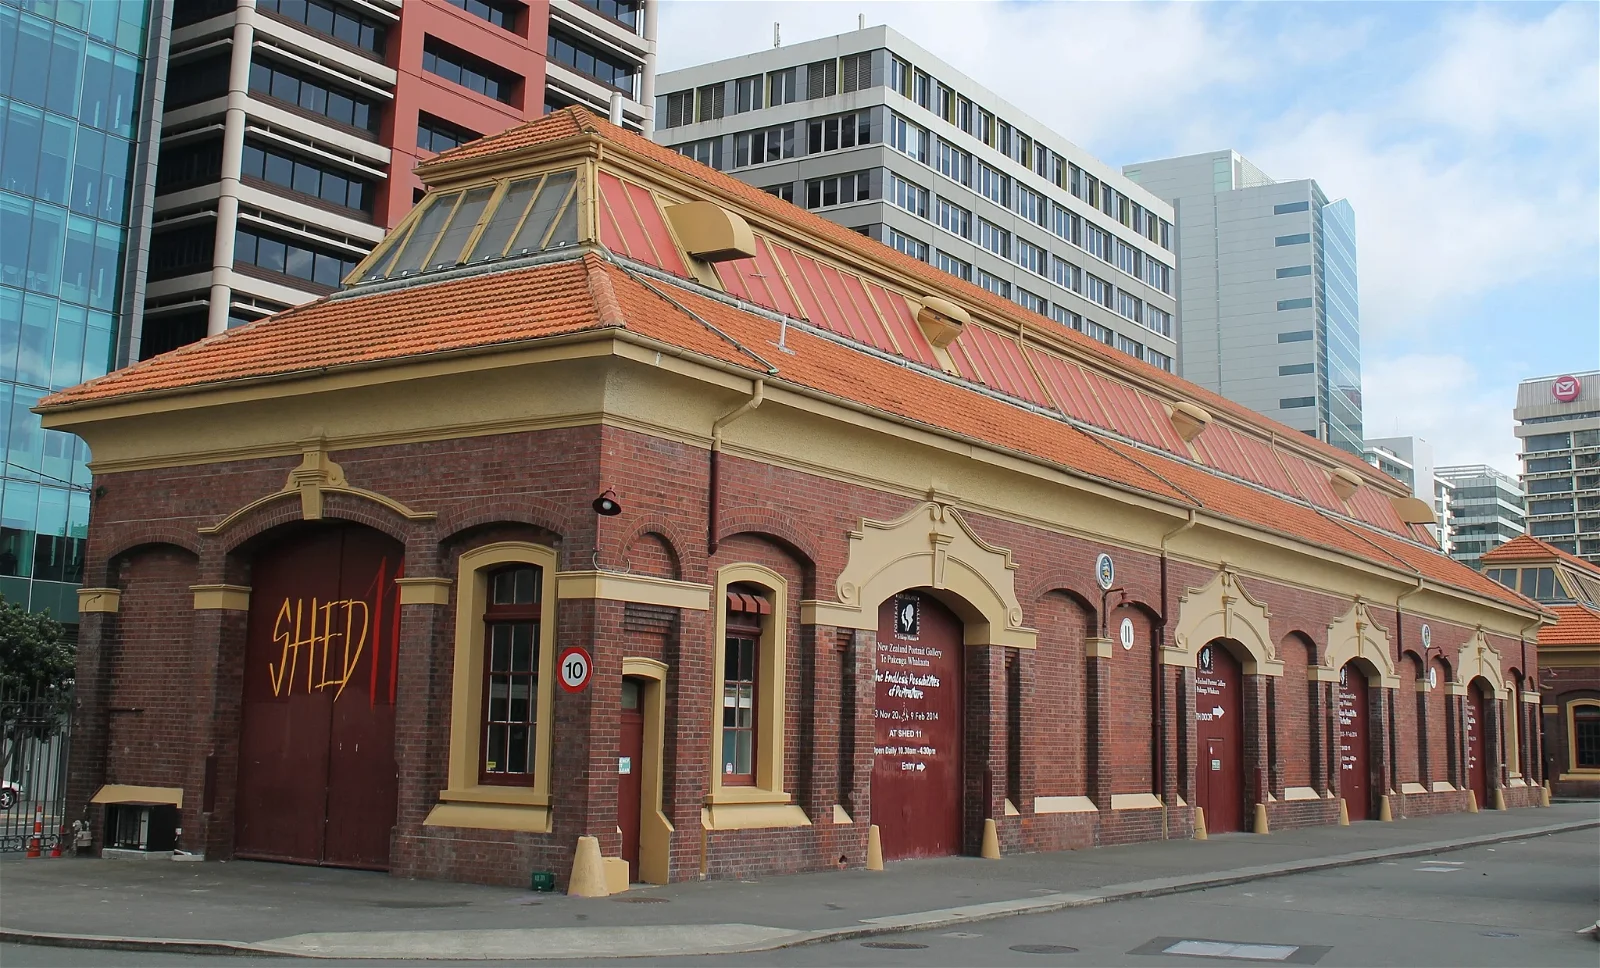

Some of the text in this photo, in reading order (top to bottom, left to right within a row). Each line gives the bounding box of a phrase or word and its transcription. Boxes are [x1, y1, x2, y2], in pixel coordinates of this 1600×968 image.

[269, 597, 368, 702] SHED
[877, 642, 943, 659] New Zealand Portrait Gallery
[880, 654, 887, 663] Te
[565, 662, 583, 679] 10
[884, 670, 908, 685] Endless
[908, 672, 940, 688] Possibilities
[879, 709, 891, 719] Nov
[915, 711, 925, 720] Feb
[926, 712, 939, 720] 2014
[1201, 713, 1213, 721] DOOR
[888, 729, 922, 738] AT SHED 11
[885, 746, 897, 756] Daily
[901, 761, 915, 771] Entry
